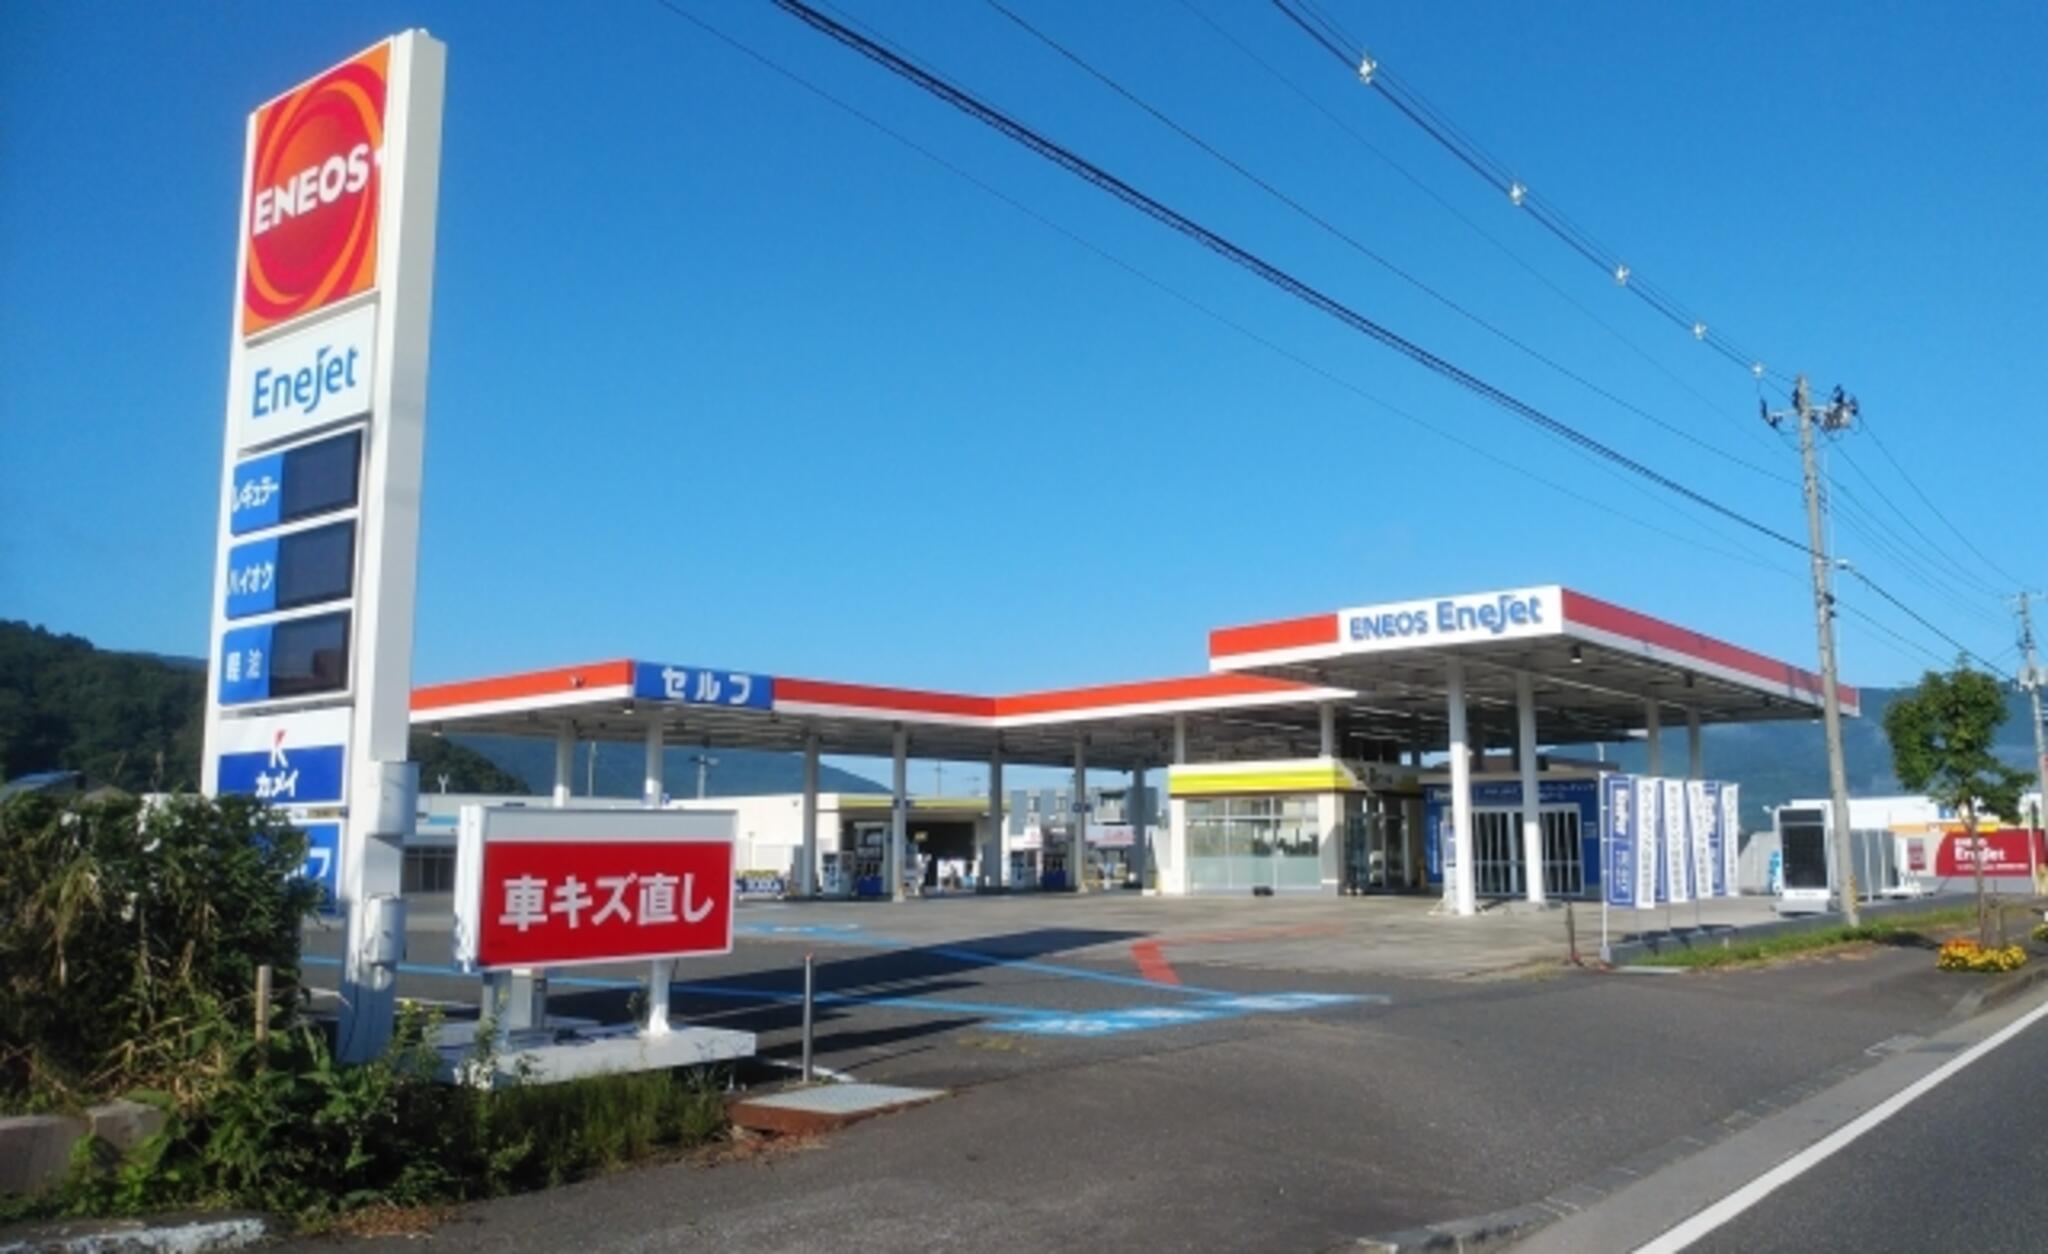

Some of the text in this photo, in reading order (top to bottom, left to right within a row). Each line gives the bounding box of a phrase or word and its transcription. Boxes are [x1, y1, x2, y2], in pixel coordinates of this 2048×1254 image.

[253, 143, 370, 236] ENEOS
[1350, 611, 1428, 641] ENEOS
[662, 666, 752, 704] セルフ
[255, 770, 299, 797] カメイ
[499, 873, 714, 931] 車キズ直し
